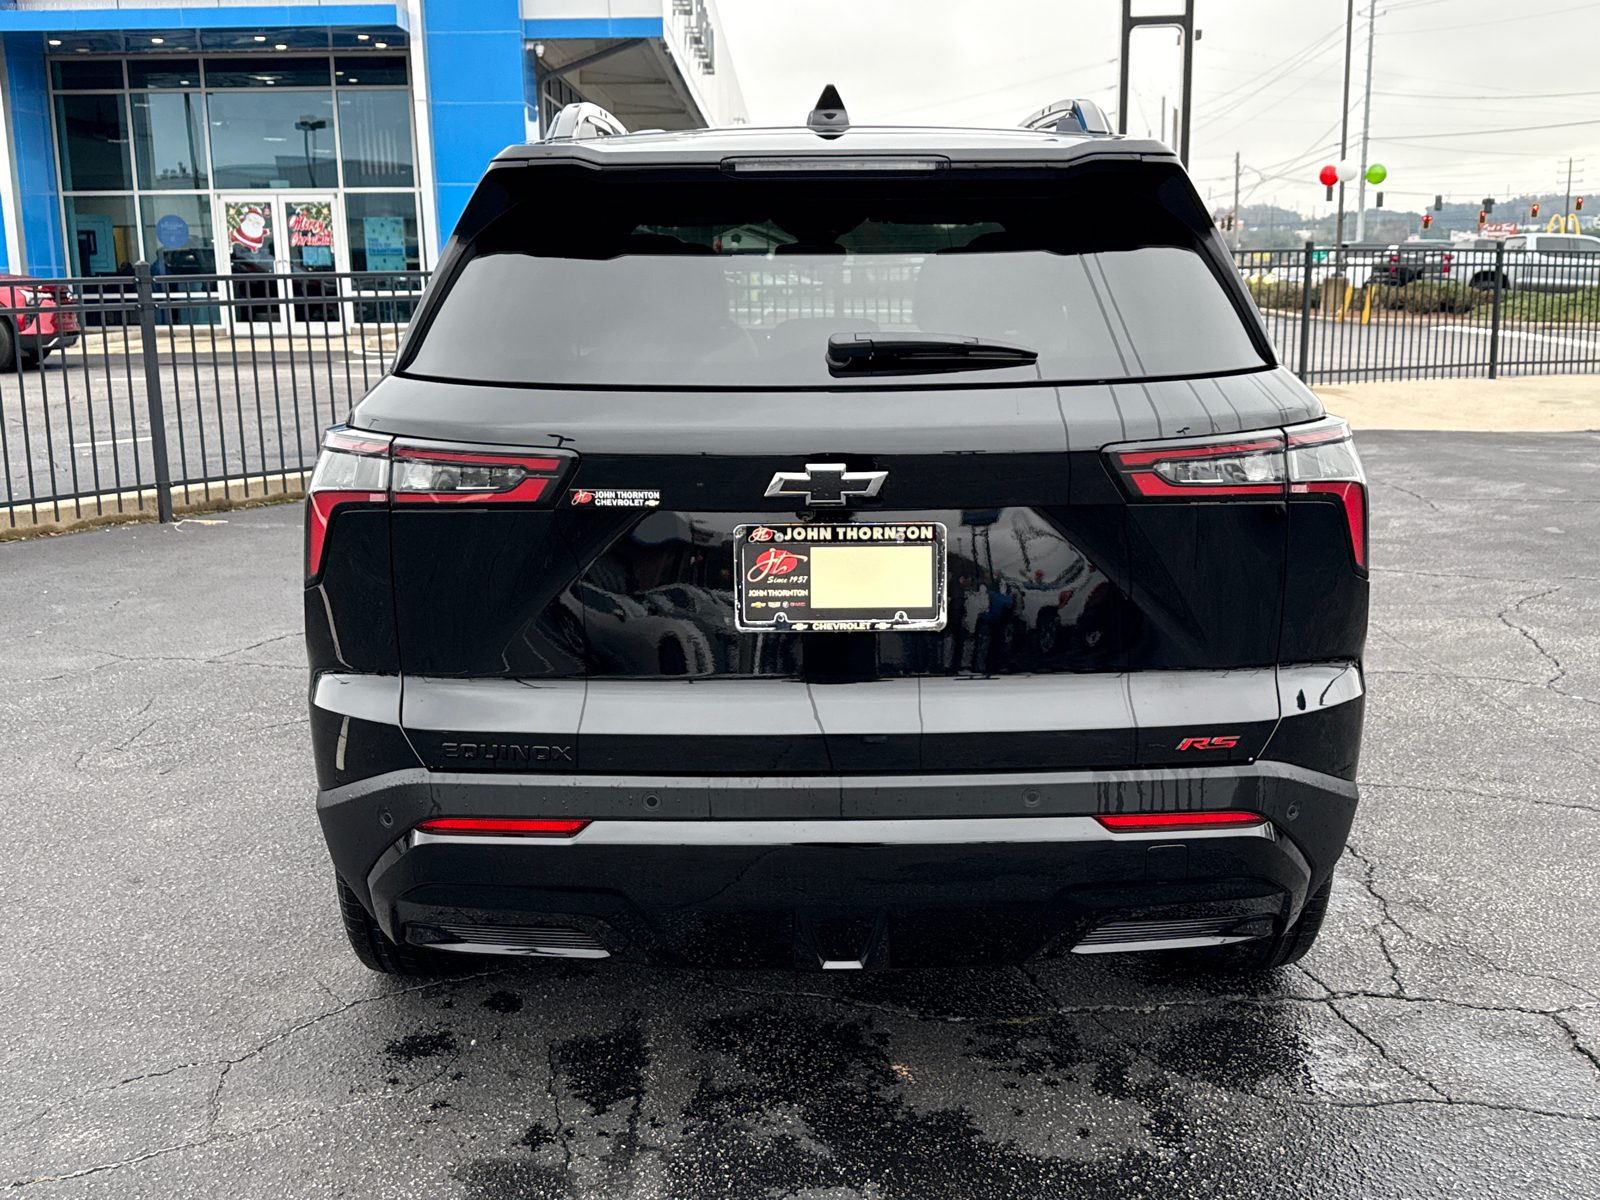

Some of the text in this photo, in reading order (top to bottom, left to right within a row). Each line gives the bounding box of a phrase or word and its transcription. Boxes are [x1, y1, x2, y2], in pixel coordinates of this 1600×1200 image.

[288, 214, 324, 235] Merry
[594, 491, 660, 499] JOHN THORNTON
[783, 526, 933, 541] JOHN THORNTON
[766, 575, 808, 583] Since 1957
[748, 589, 808, 597] JOHN THORNTON
[812, 622, 871, 631] CHEVROLET
[1175, 736, 1241, 750] RS
[441, 742, 573, 761] EQUINOX
